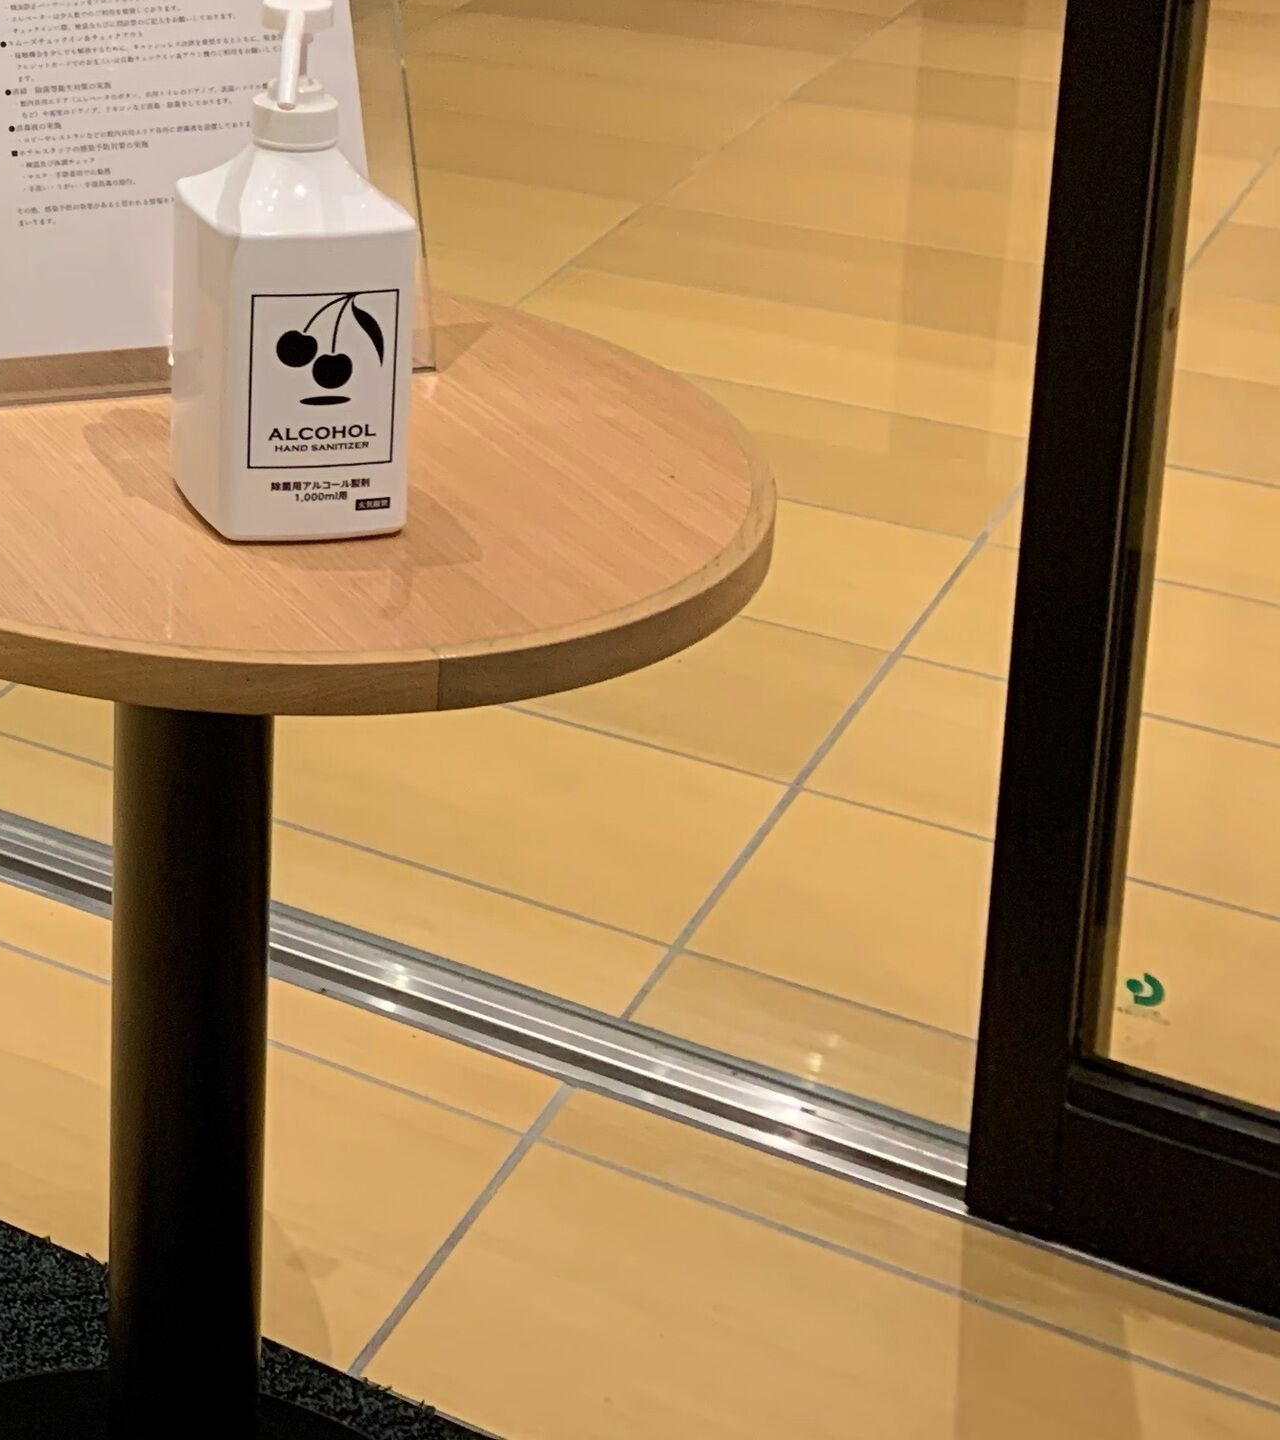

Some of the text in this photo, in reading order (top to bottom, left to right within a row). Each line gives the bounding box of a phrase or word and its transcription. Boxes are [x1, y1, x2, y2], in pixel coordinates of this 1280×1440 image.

[268, 424, 376, 441] ALCOHOL
[274, 441, 370, 453] HAND SANITIZER
[270, 478, 371, 492] 除菌用アルコール製剤
